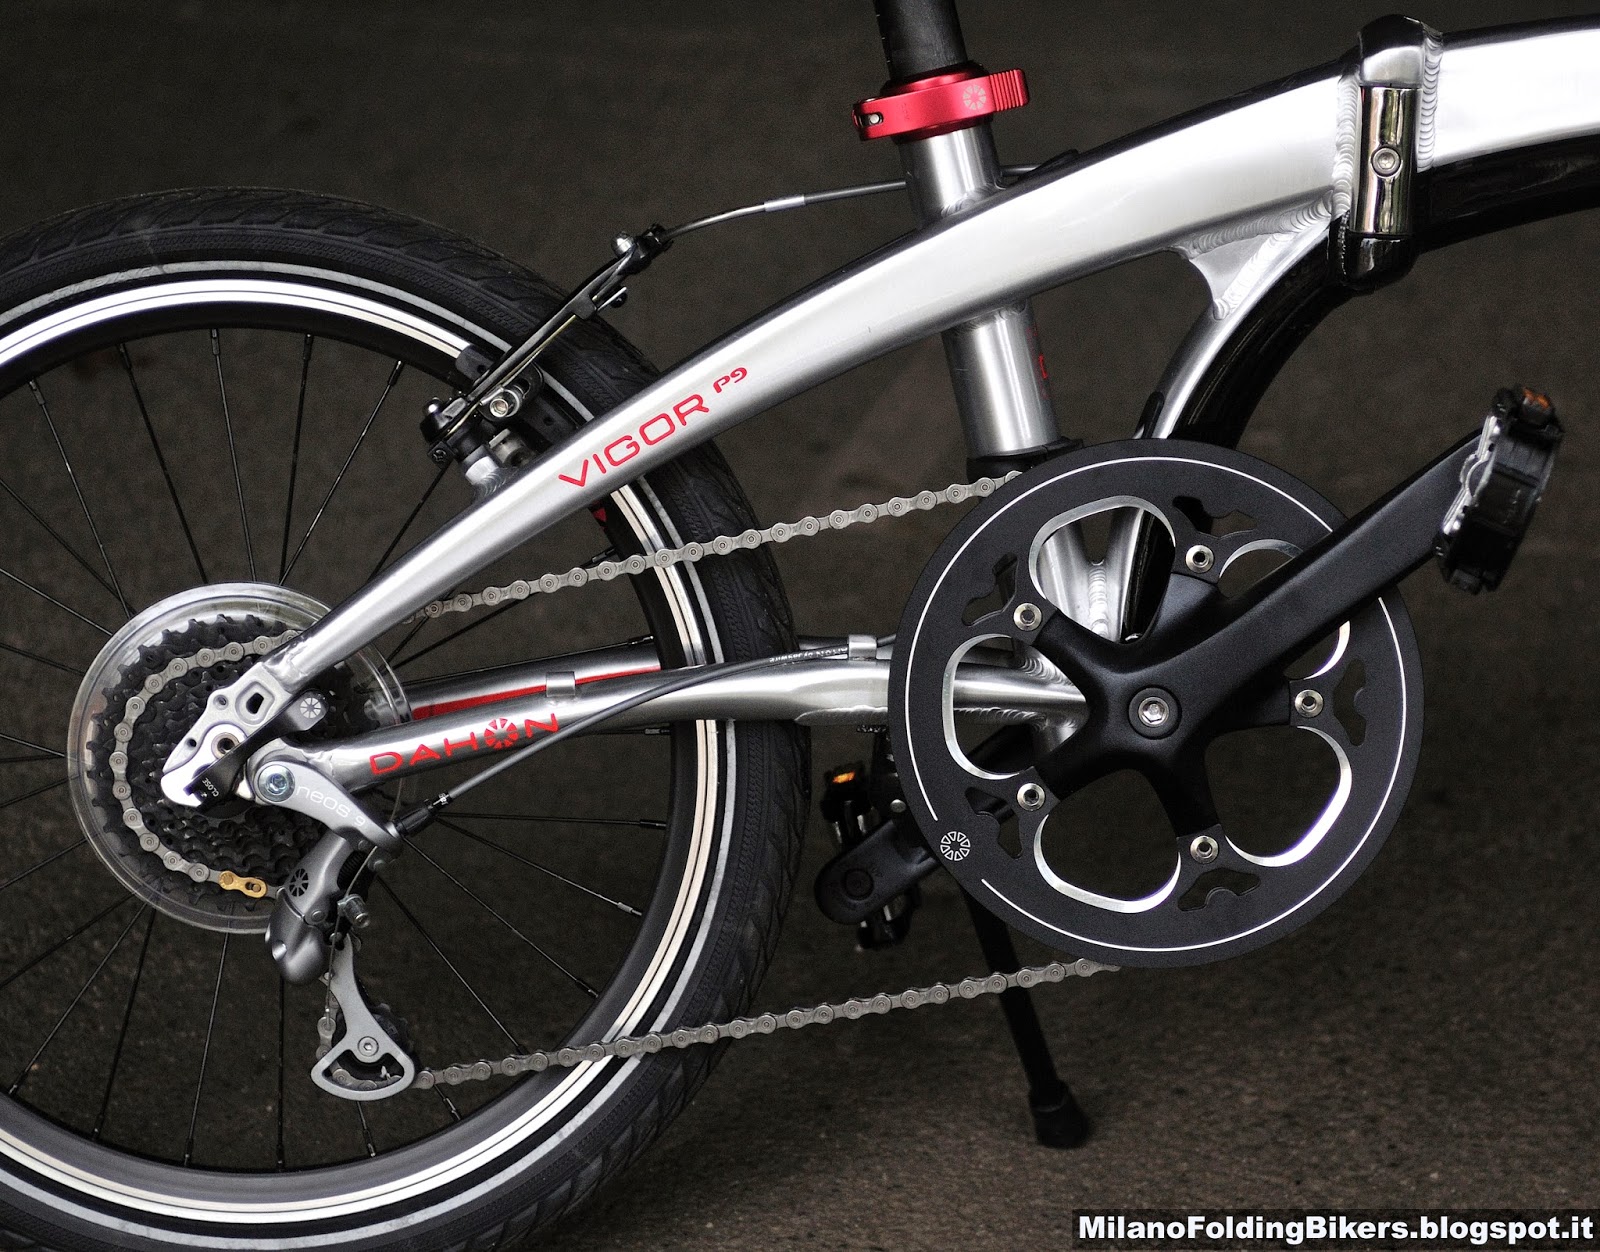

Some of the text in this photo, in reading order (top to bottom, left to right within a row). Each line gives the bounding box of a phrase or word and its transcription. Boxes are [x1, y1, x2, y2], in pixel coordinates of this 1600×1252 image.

[557, 366, 748, 488] VIGOR P9
[368, 712, 560, 776] DAHON
[201, 777, 220, 797] CLOSE
[295, 786, 351, 818] neos
